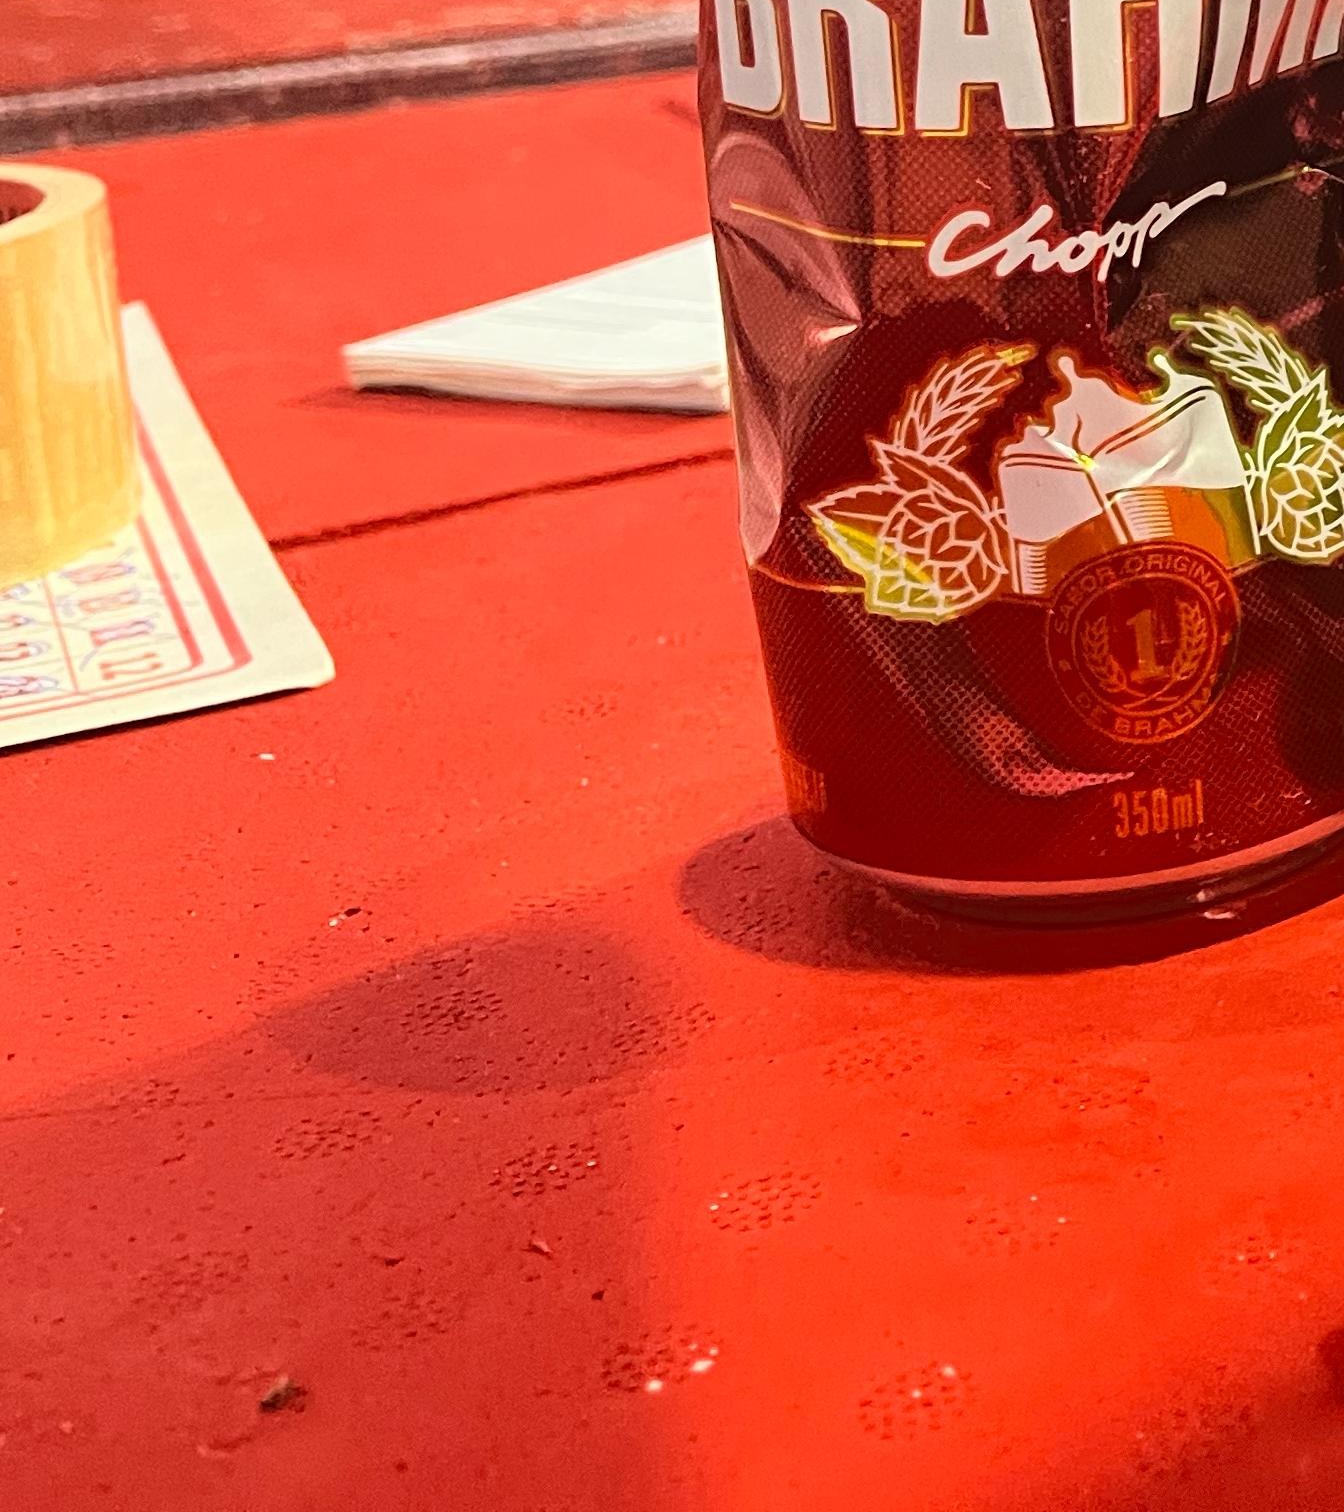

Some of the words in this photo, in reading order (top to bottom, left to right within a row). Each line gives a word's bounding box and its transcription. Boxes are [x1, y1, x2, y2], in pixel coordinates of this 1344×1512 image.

[925, 181, 1227, 282] Chopp
[1124, 553, 1226, 611] ORIGINAL
[1126, 609, 1170, 684] 1
[1113, 784, 1205, 838] 350ml
